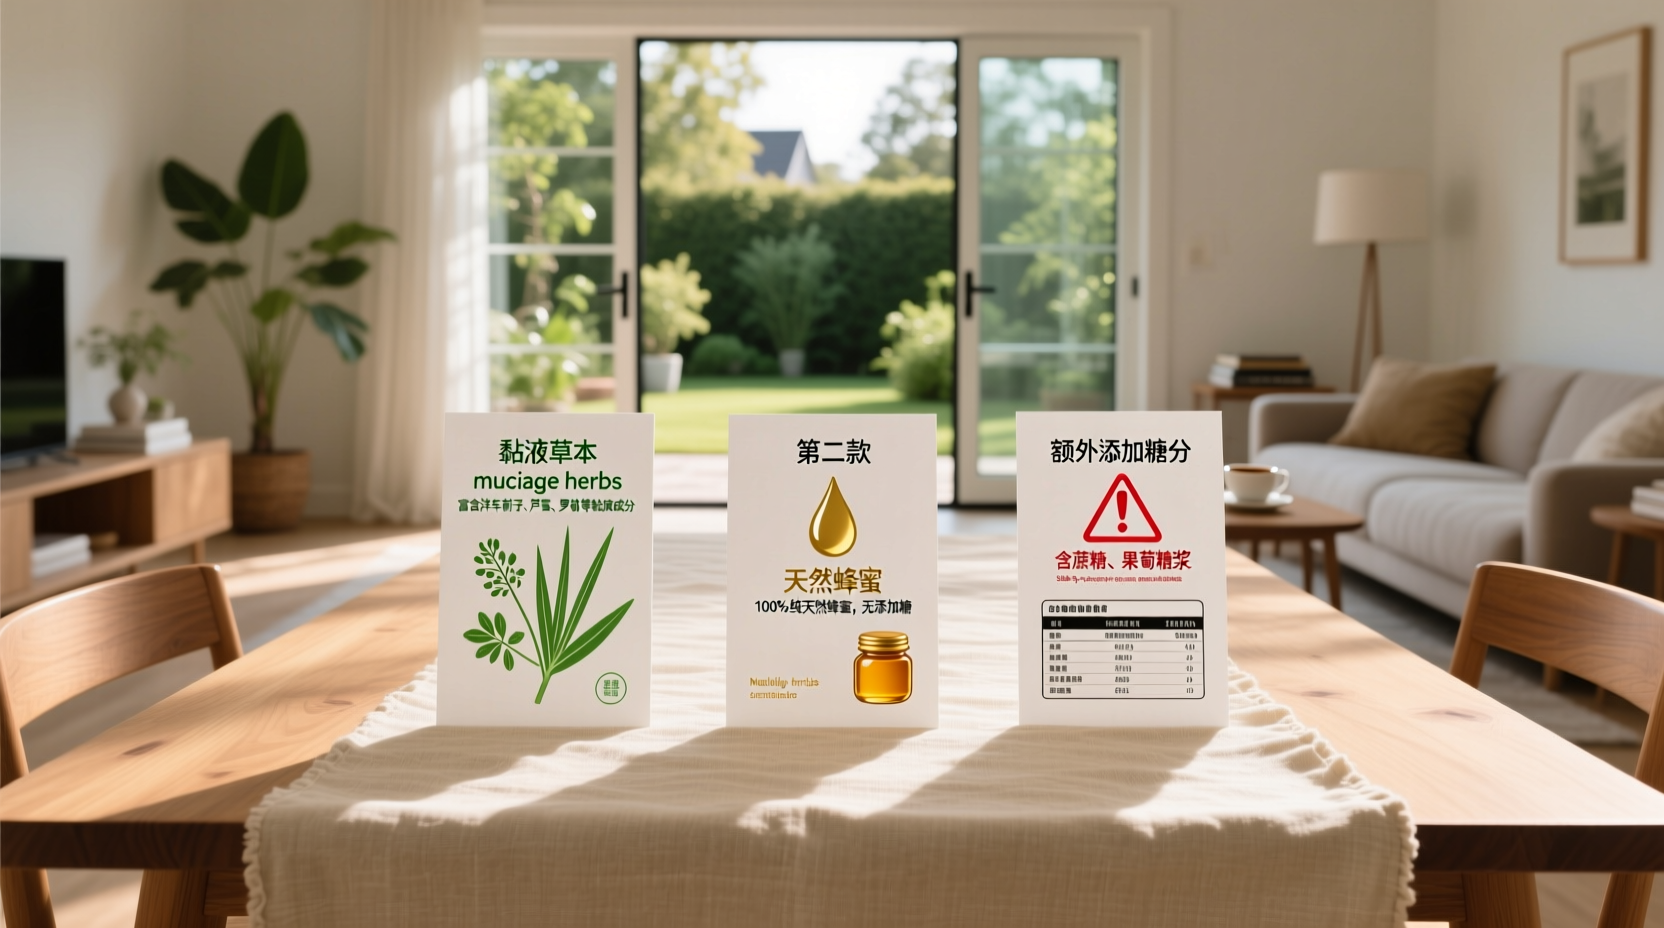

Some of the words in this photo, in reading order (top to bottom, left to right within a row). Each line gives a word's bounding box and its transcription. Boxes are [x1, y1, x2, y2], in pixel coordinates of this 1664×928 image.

[797, 438, 871, 465] 第二款
[1050, 438, 1191, 464] 额外添加糖分
[474, 471, 559, 495] muciage
[566, 471, 622, 490] herbs
[784, 566, 882, 595] 天然蜂蜜
